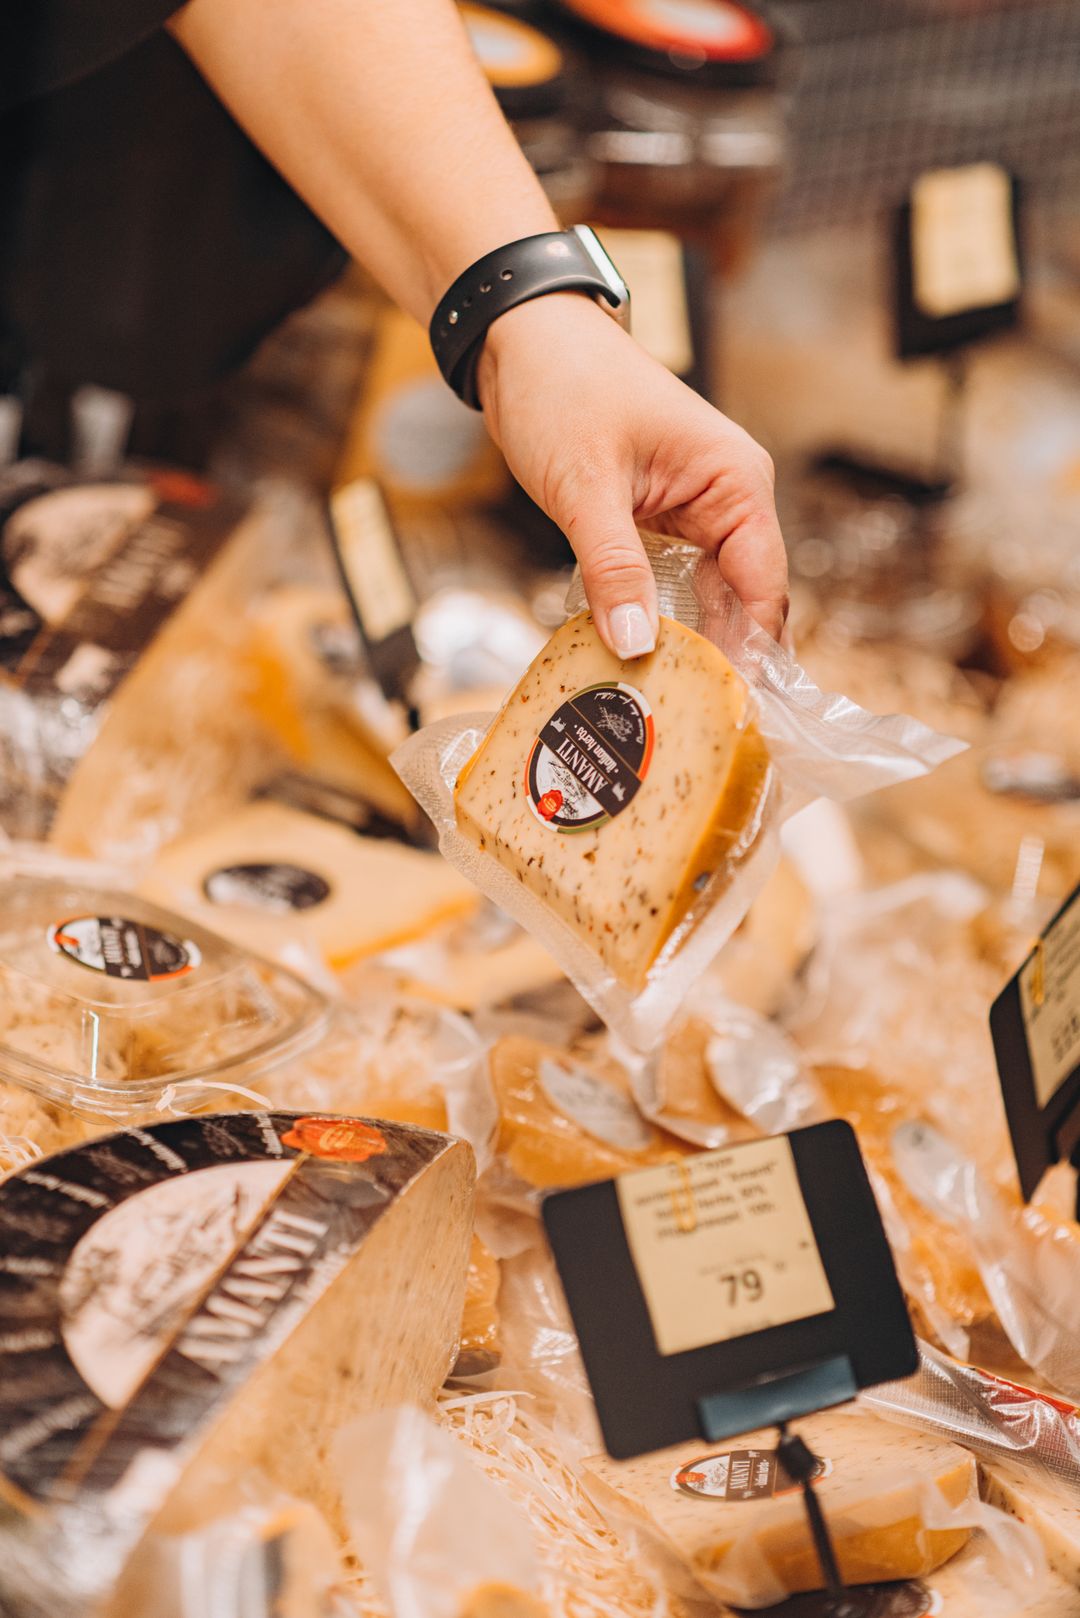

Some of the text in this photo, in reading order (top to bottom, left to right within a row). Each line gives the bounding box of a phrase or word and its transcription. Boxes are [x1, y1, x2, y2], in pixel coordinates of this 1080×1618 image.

[576, 729, 598, 752] herbs
[555, 737, 609, 794] AMANTI
[719, 1269, 764, 1306] 79
[730, 1460, 750, 1489] AMANTI
